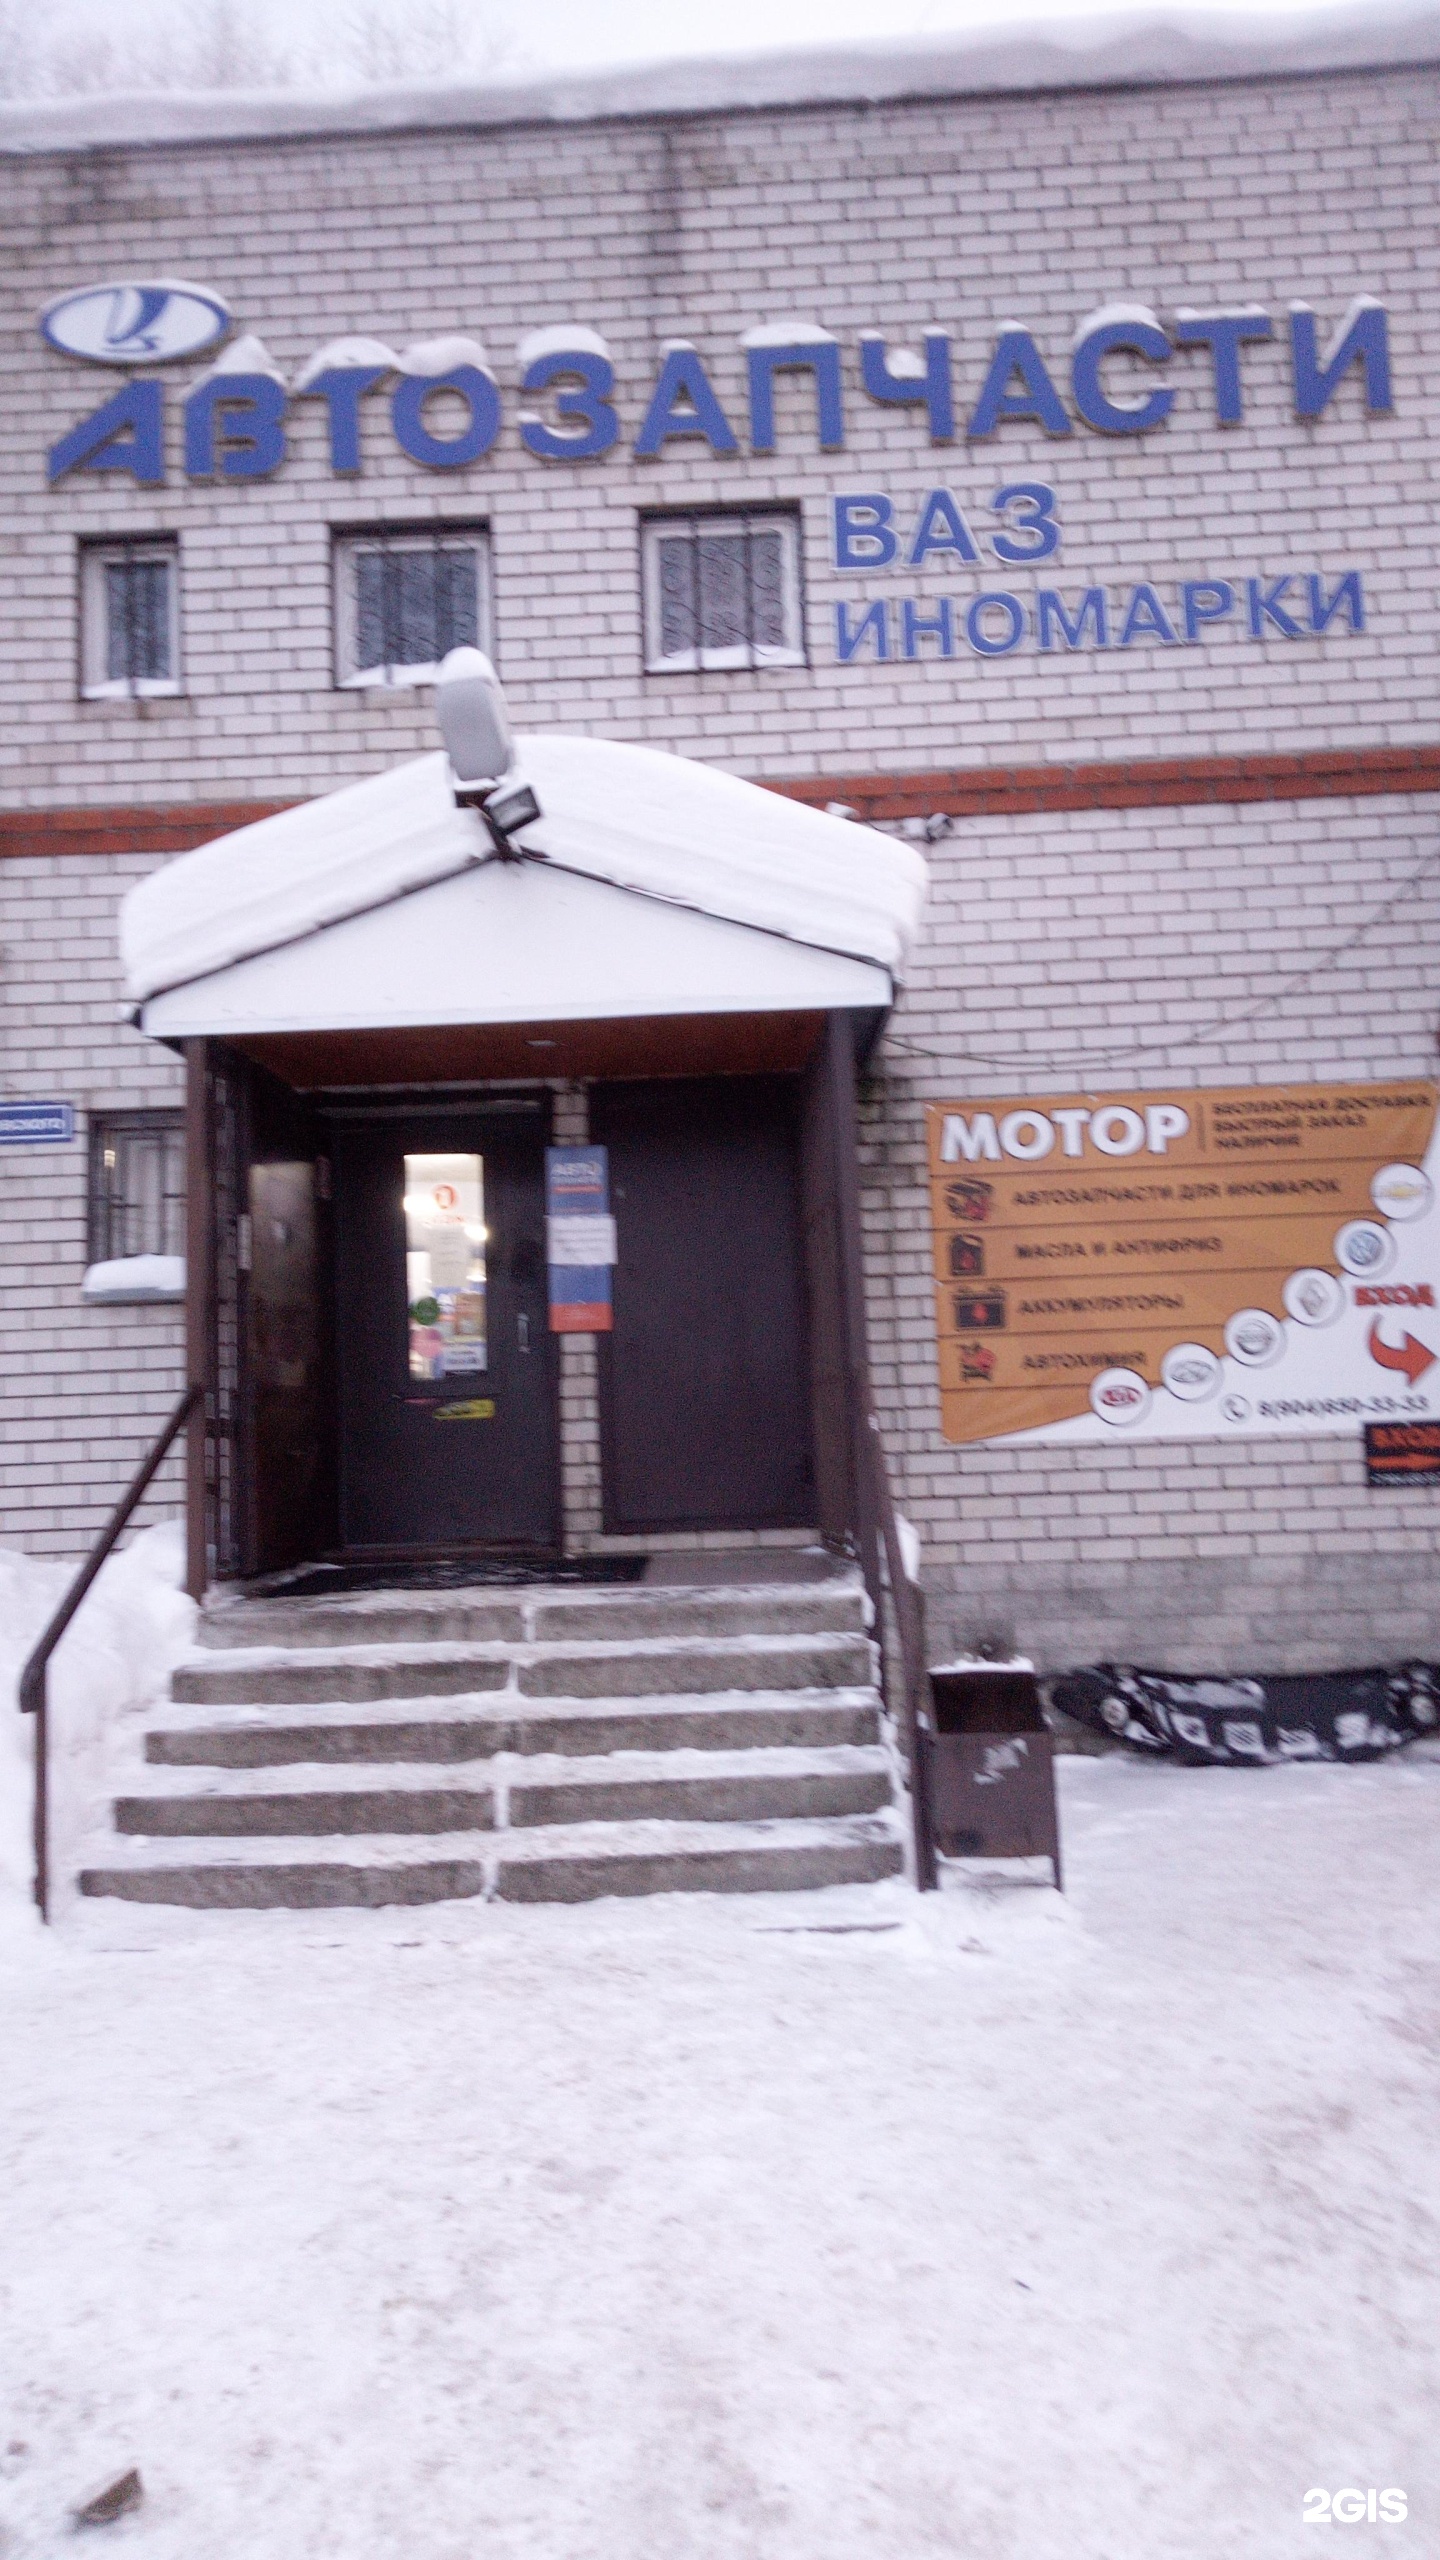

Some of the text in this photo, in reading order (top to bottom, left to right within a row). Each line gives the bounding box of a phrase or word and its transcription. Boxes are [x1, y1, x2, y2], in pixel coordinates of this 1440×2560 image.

[47, 305, 1394, 487] АВТОЗАПЧАСТИ
[832, 481, 1062, 570] ВАЗ
[834, 570, 1364, 663] ИНОМАРКИ
[1334, 1093, 1431, 1110] ДОСТАВКА
[940, 1104, 1190, 1161] МОТОР
[1307, 1113, 1367, 1129] ЗАКАЗ
[1013, 1177, 1341, 1206] АВТОЗАПЧАСТИ ДЛЯ ИНОМАРОК
[1016, 1236, 1223, 1259] МАСЛА И АНТИФРИЗ
[1019, 1294, 1183, 1313] АККУМУЛЯТОРЫ
[1354, 1283, 1435, 1307] ВХОД
[1022, 1351, 1147, 1370] АВТОХИМИЯ
